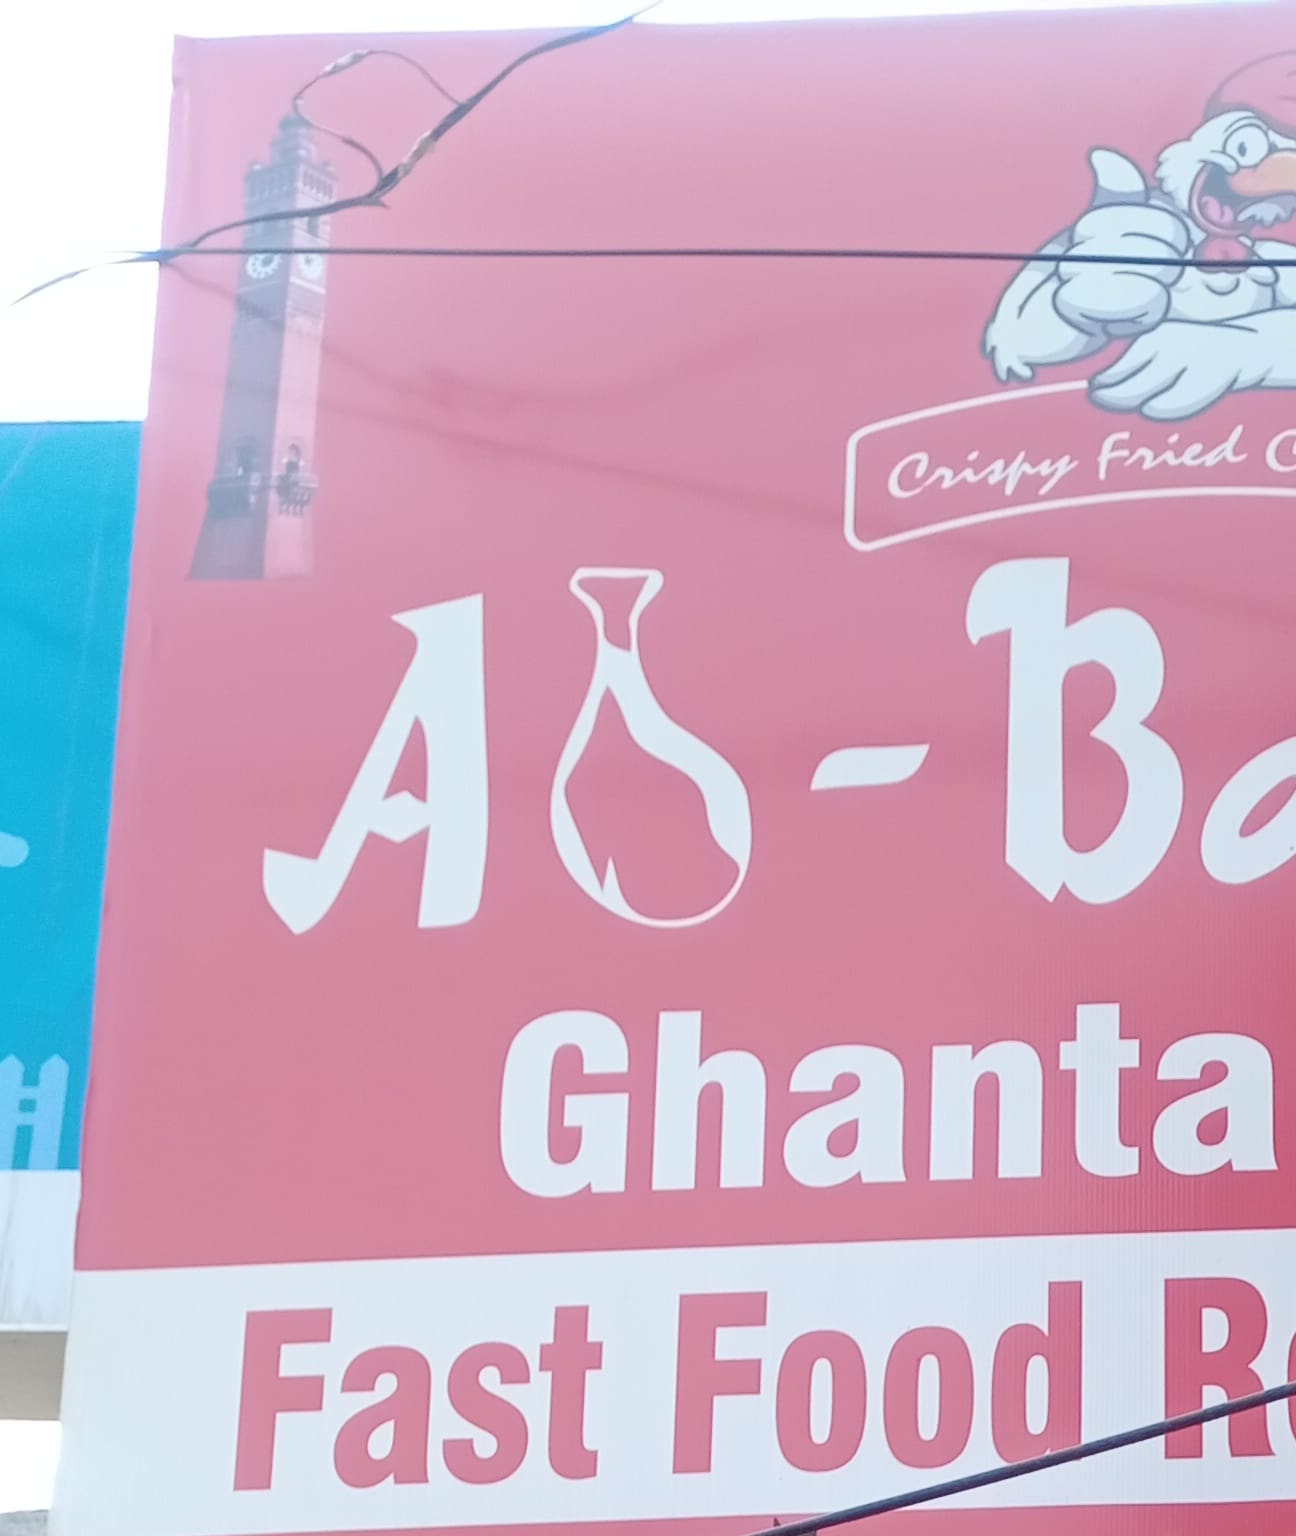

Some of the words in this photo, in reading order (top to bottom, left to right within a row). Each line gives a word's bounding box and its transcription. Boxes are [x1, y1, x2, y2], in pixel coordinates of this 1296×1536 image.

[888, 450, 1080, 498] Crispy
[1098, 424, 1248, 480] Fried
[499, 1002, 1278, 1199] Ghanta
[233, 1305, 604, 1491] Fast
[672, 1280, 1083, 1474] Food
